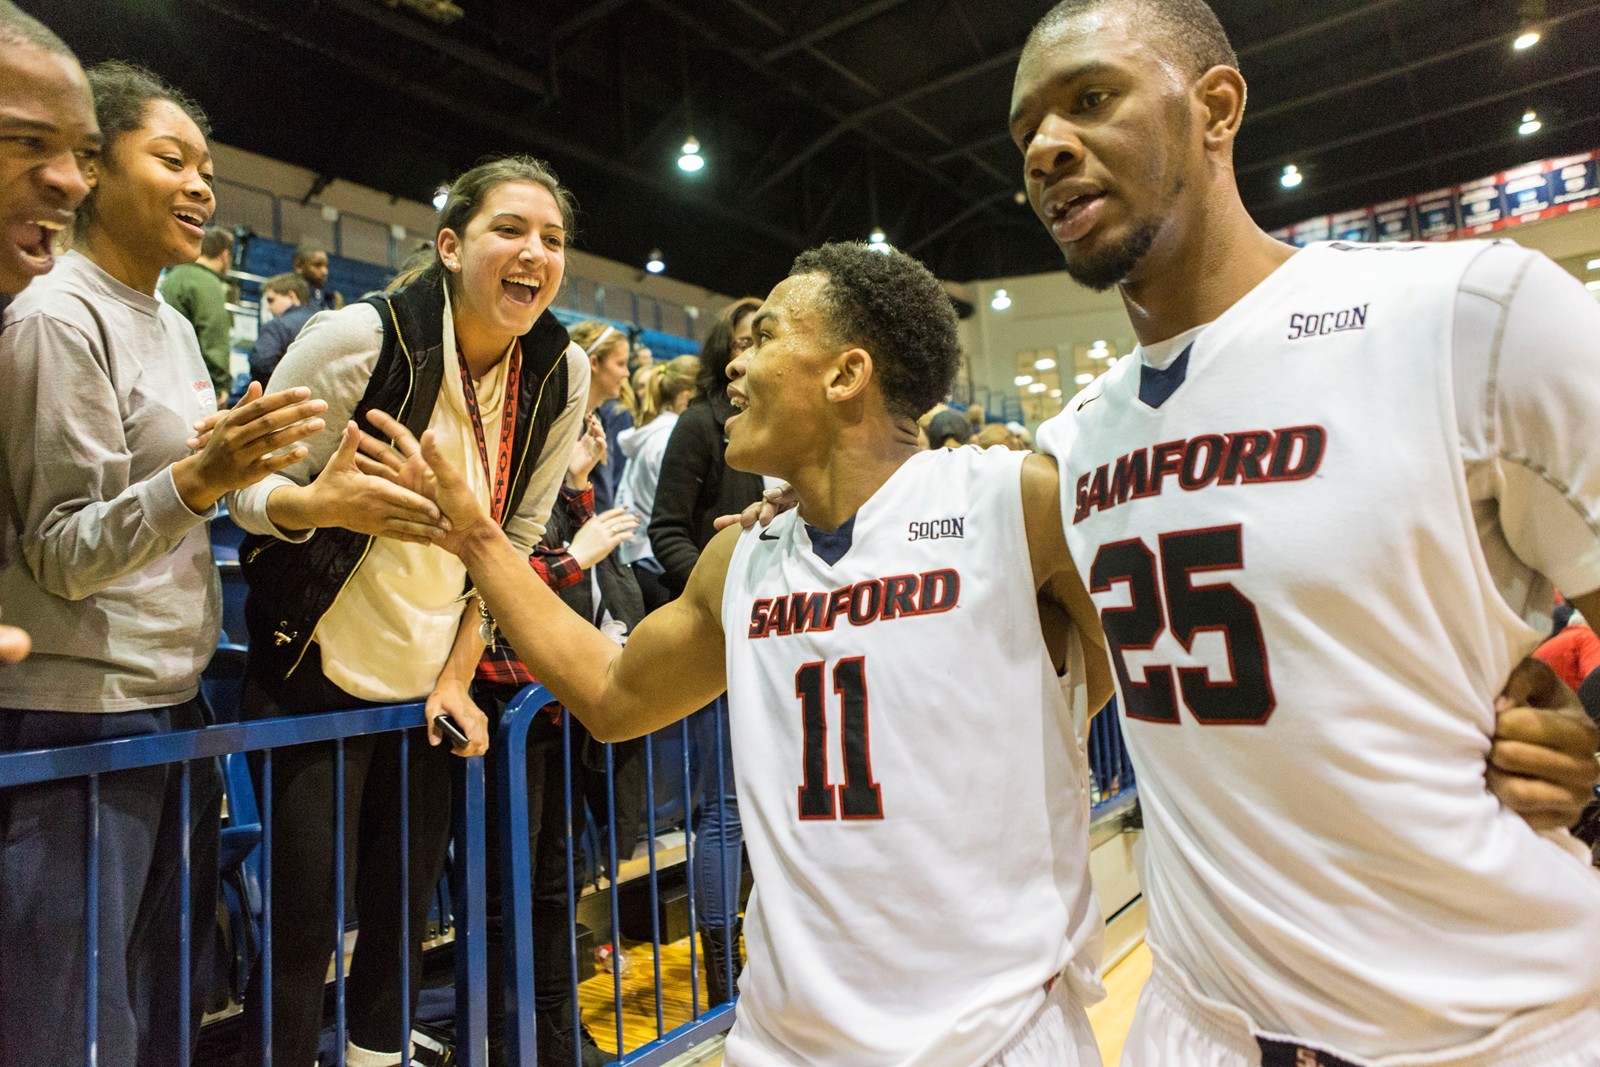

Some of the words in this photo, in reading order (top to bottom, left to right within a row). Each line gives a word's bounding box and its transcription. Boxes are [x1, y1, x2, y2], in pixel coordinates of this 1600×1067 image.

[501, 367, 516, 450] OAKLEY
[1073, 425, 1328, 525] SAMFORD
[748, 568, 960, 639] SAMFORD
[1089, 523, 1277, 726] 25
[795, 656, 884, 820] 11
